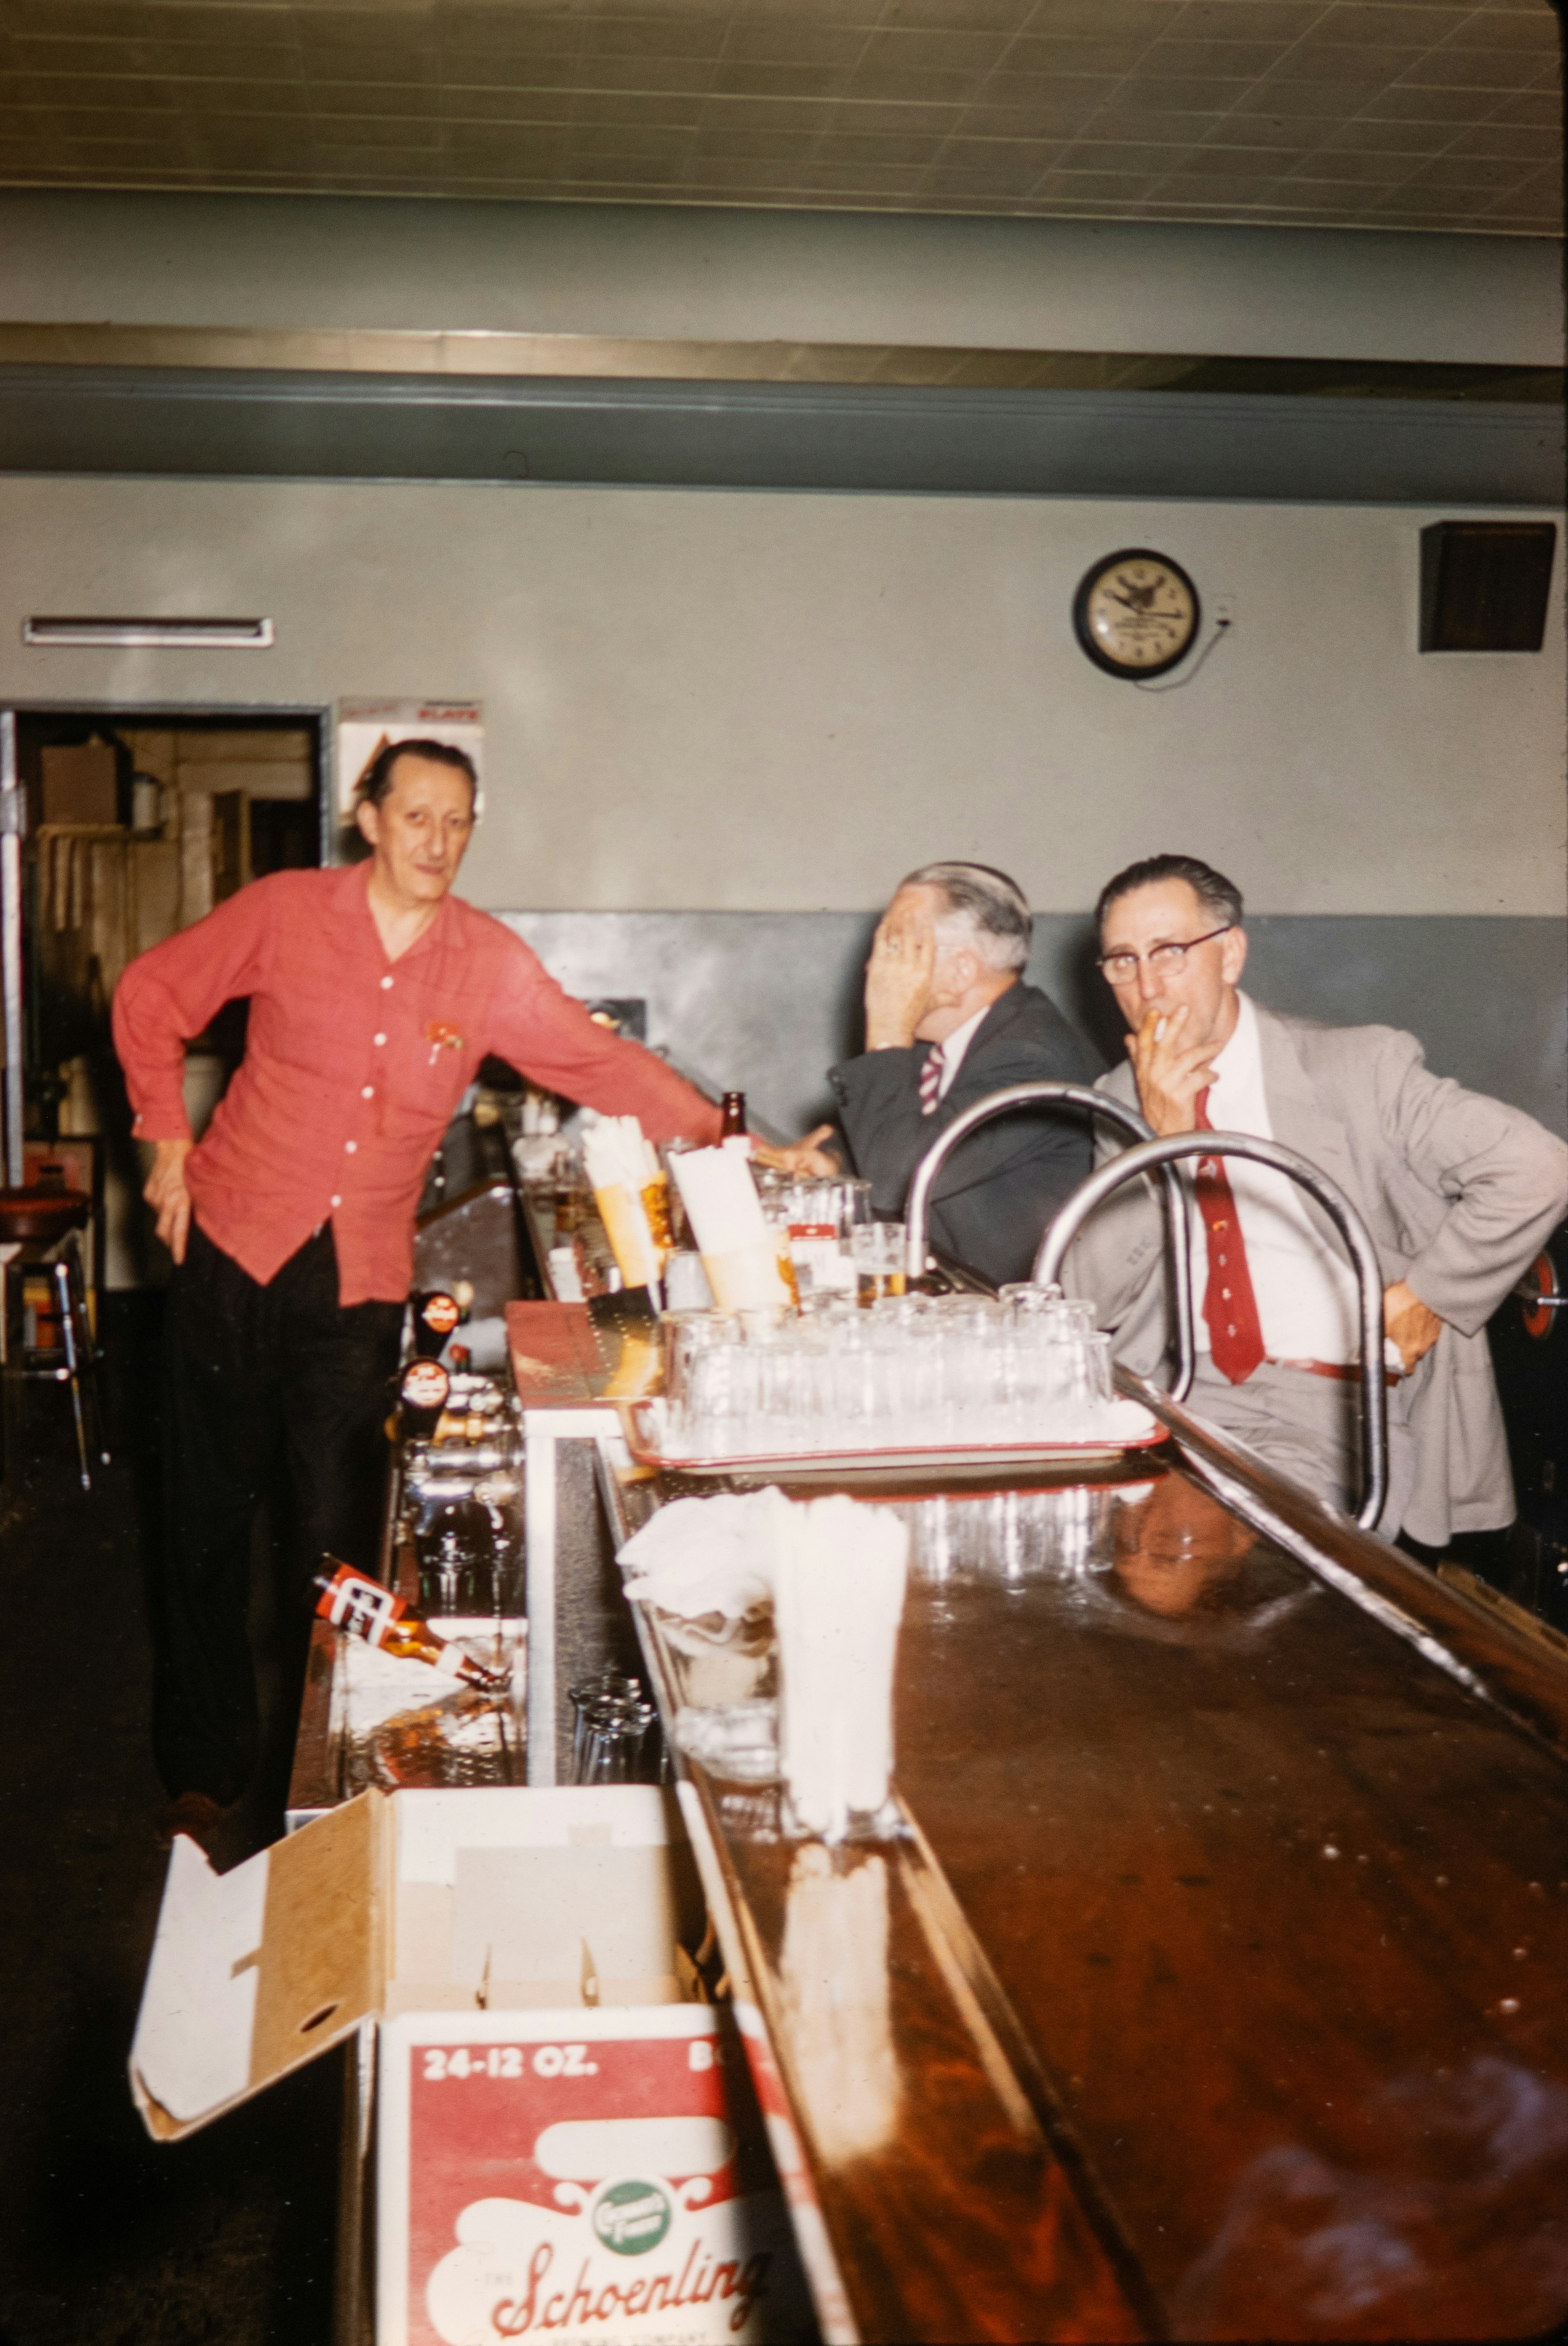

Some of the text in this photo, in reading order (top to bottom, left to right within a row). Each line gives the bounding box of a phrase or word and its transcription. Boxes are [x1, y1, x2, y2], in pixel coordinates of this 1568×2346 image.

[423, 2047, 523, 2080] 24-12
[532, 2044, 598, 2077] OZ.
[491, 2238, 771, 2337] Schoenling
